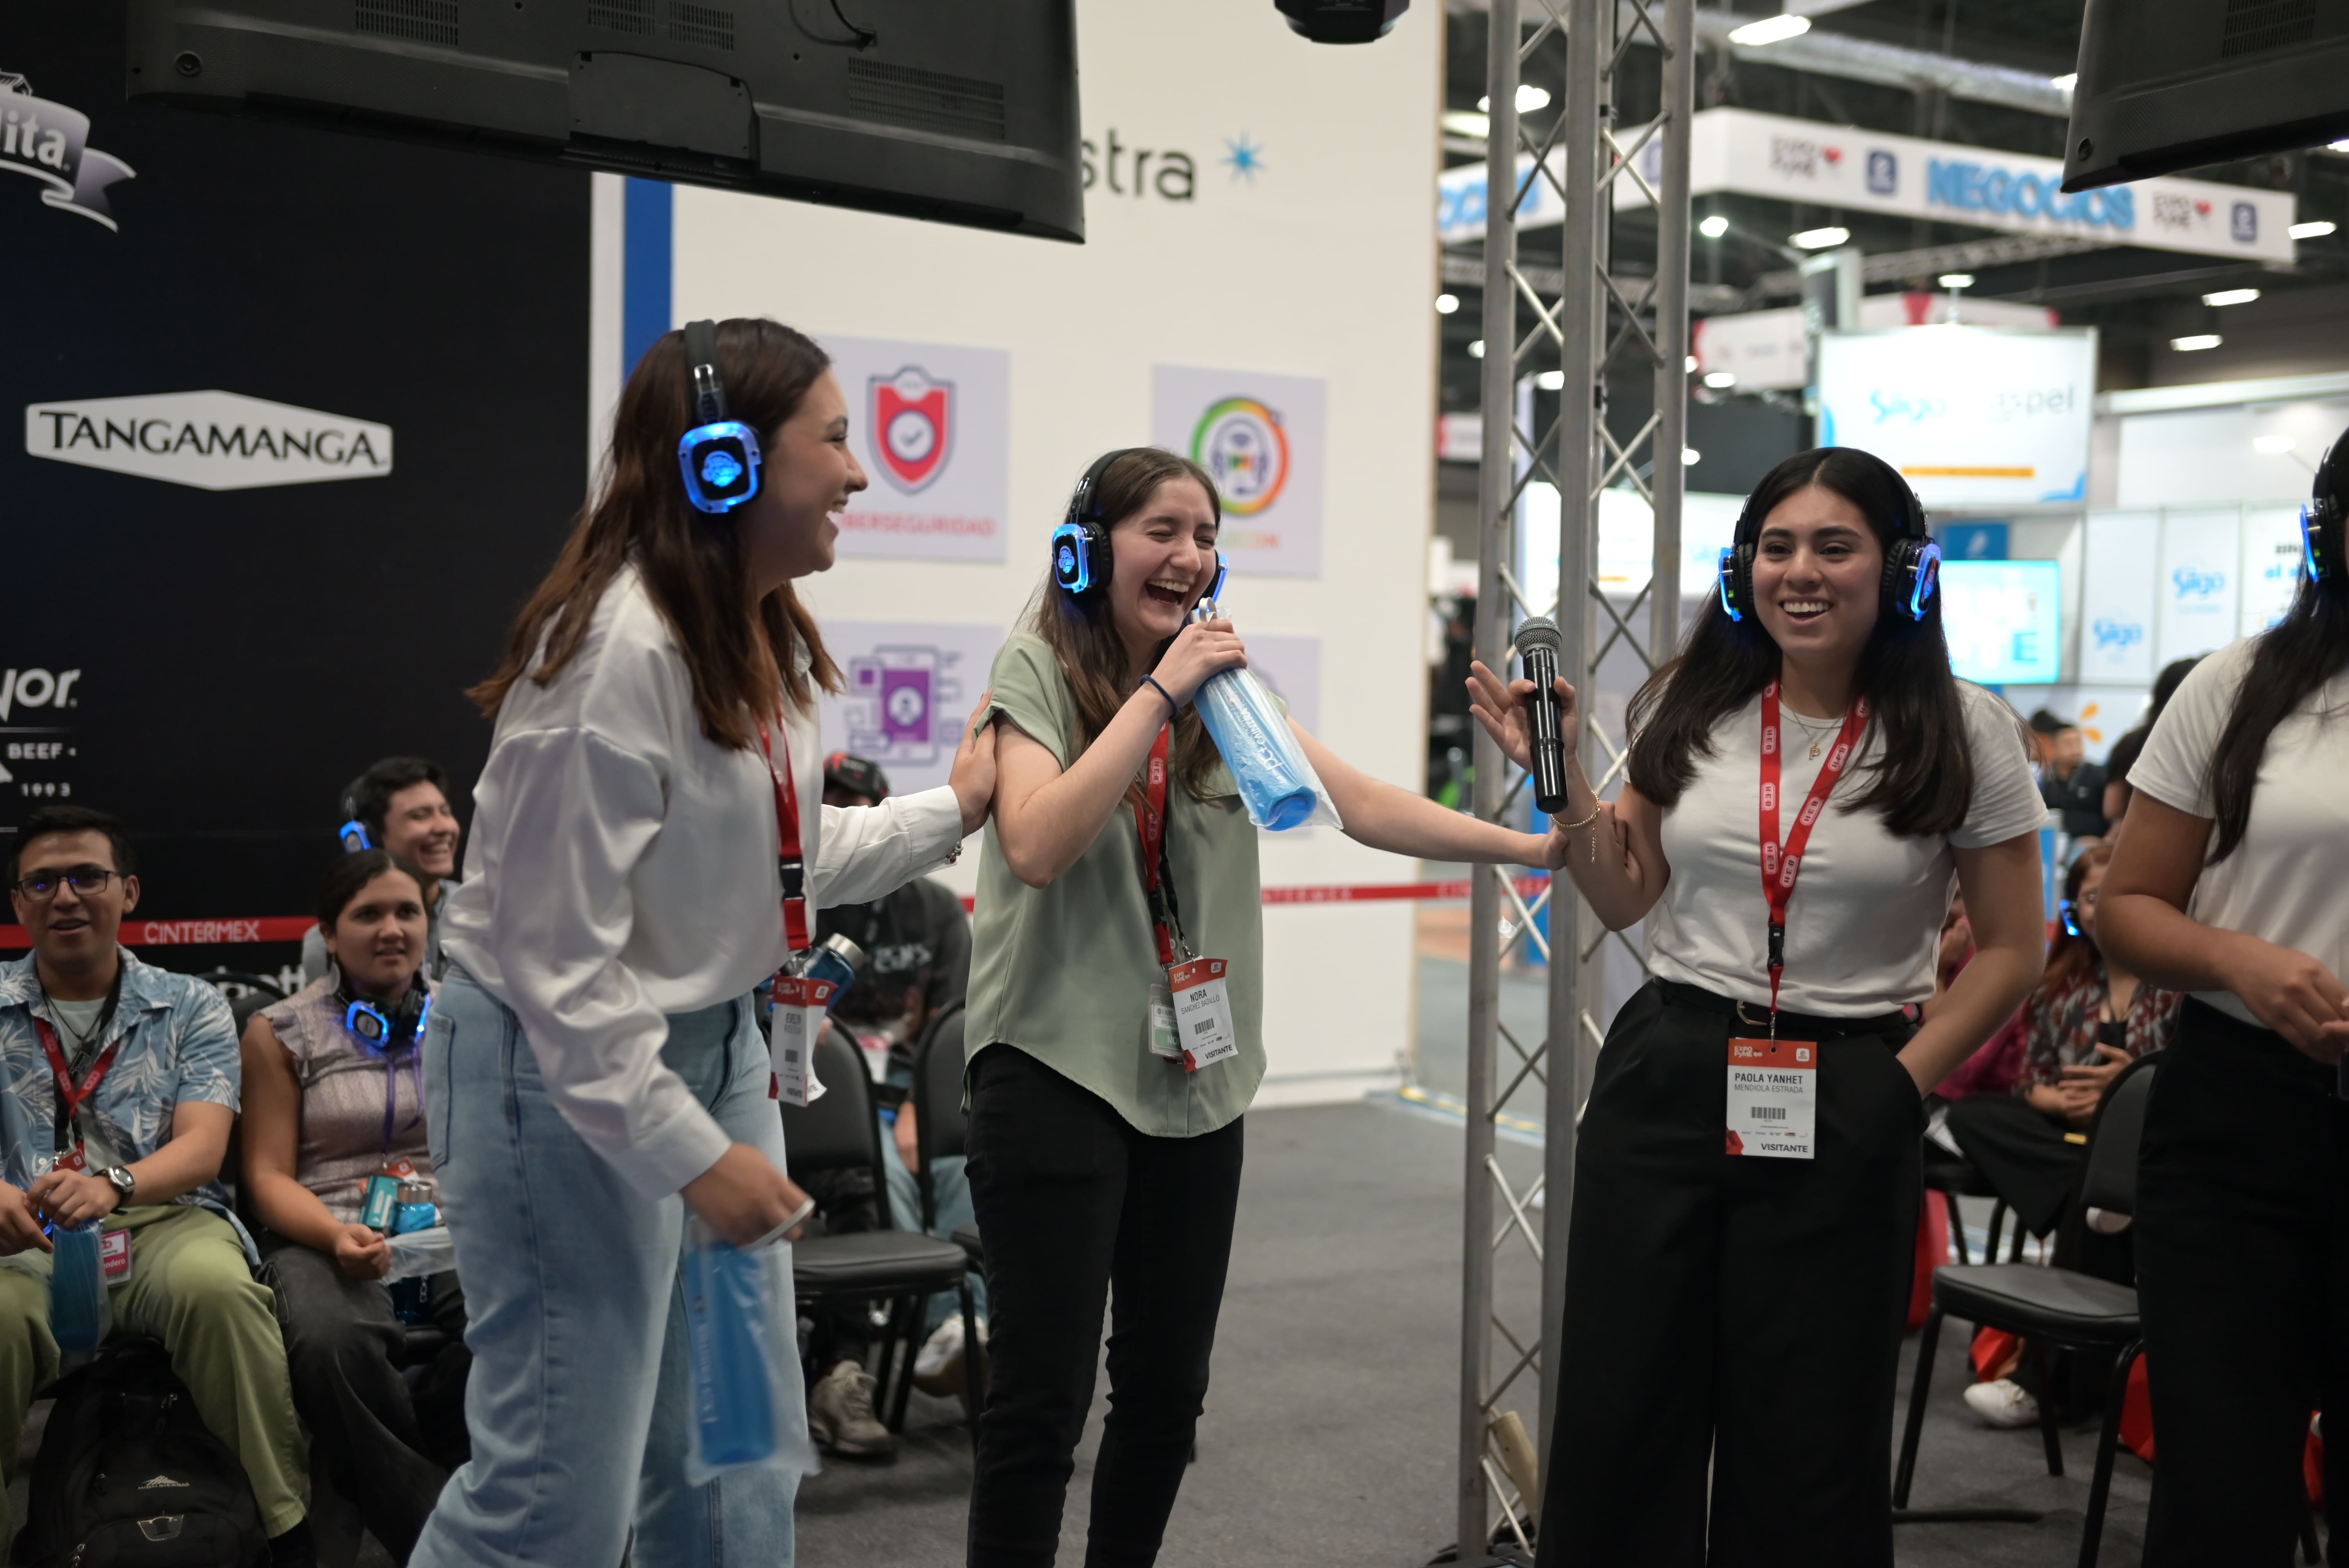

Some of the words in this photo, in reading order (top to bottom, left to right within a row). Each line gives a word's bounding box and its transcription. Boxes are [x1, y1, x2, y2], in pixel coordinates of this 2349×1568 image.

[0, 108, 66, 169] ita
[39, 411, 378, 468] TANGAMANGA
[8, 743, 63, 759] BEEF
[145, 920, 260, 943] CINTERMEX
[1190, 989, 1207, 1003] NORA
[1181, 1002, 1201, 1014] SANCHEZ
[1201, 995, 1220, 1007] BADILLO
[1205, 1044, 1233, 1059] VISITANTE
[1735, 1073, 1764, 1083] PAOLA
[1767, 1074, 1803, 1084] YANHET
[1772, 1085, 1803, 1093] ESTRADA
[1761, 1143, 1808, 1153] VISITANTE
